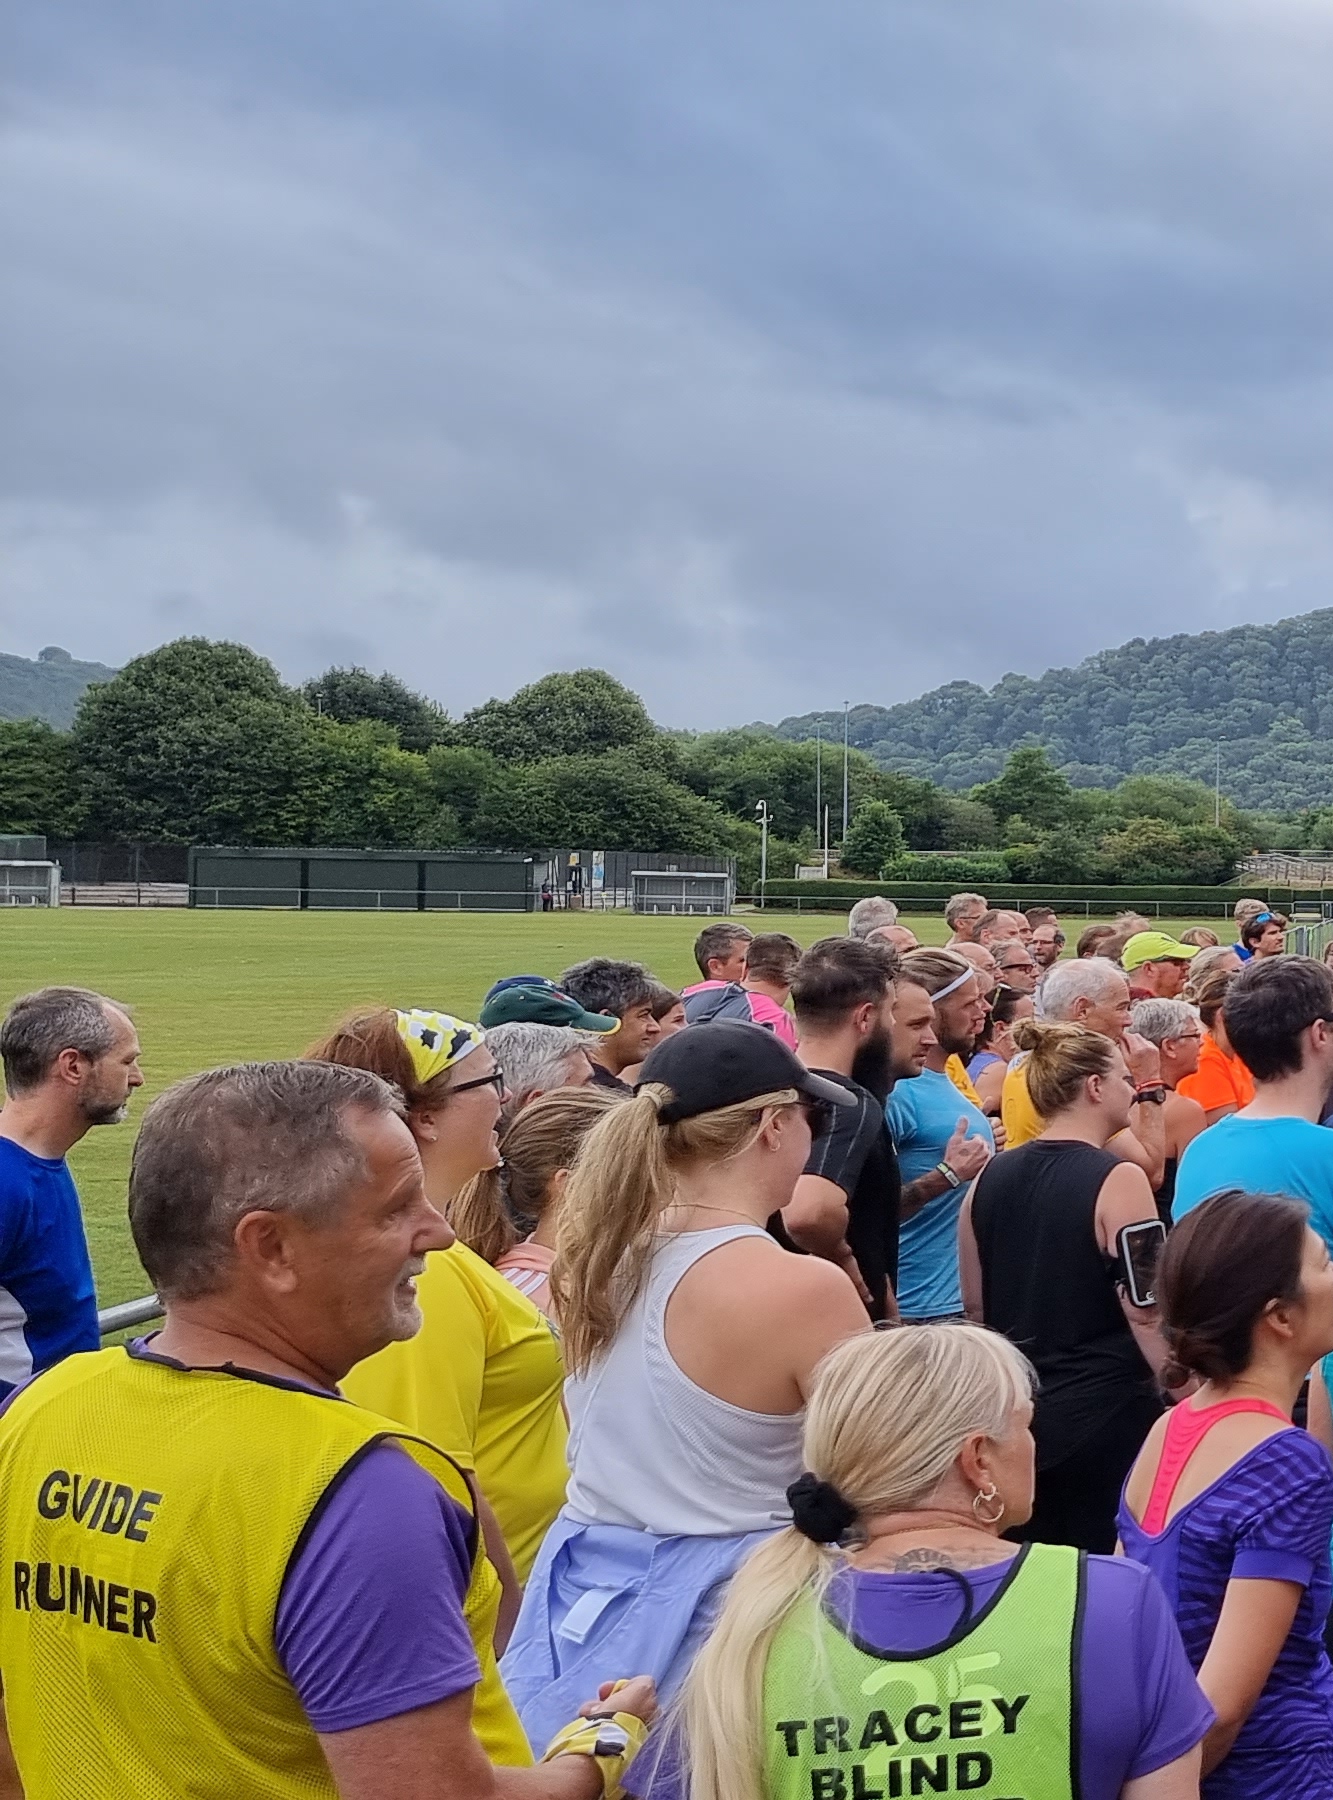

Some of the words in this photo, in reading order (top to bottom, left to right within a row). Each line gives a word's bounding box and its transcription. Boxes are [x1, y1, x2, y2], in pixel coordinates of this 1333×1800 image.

[38, 1470, 163, 1542] GUIDE
[14, 1561, 157, 1644] RUNNER
[776, 1695, 1031, 1758] TRACEY
[811, 1751, 993, 1800] BLIND
